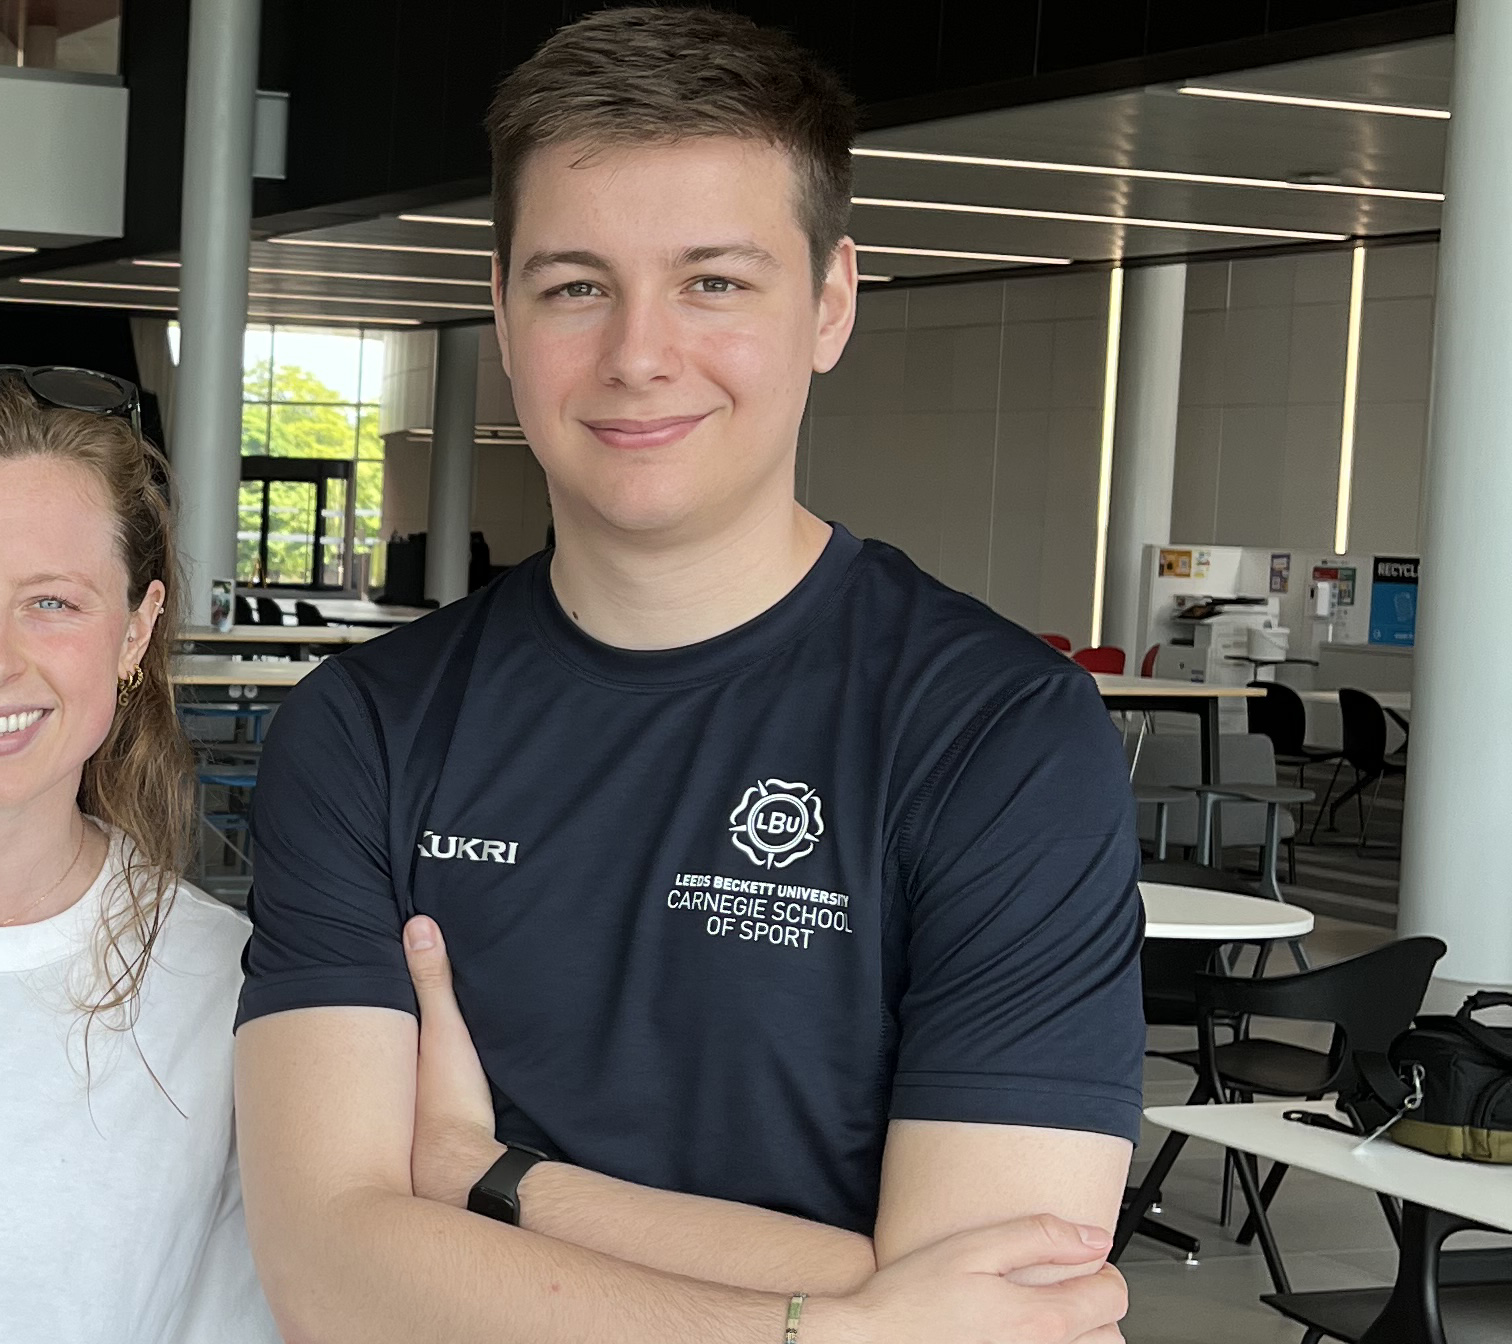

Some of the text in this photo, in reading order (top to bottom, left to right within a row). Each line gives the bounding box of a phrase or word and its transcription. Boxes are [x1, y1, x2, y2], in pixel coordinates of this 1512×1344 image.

[756, 811, 800, 834] LBU
[675, 873, 849, 908] LEEDS BECKETT UNIVERSITY
[667, 889, 853, 933] CARNEGIE SCHOOL
[706, 916, 815, 950] OF SPORT
